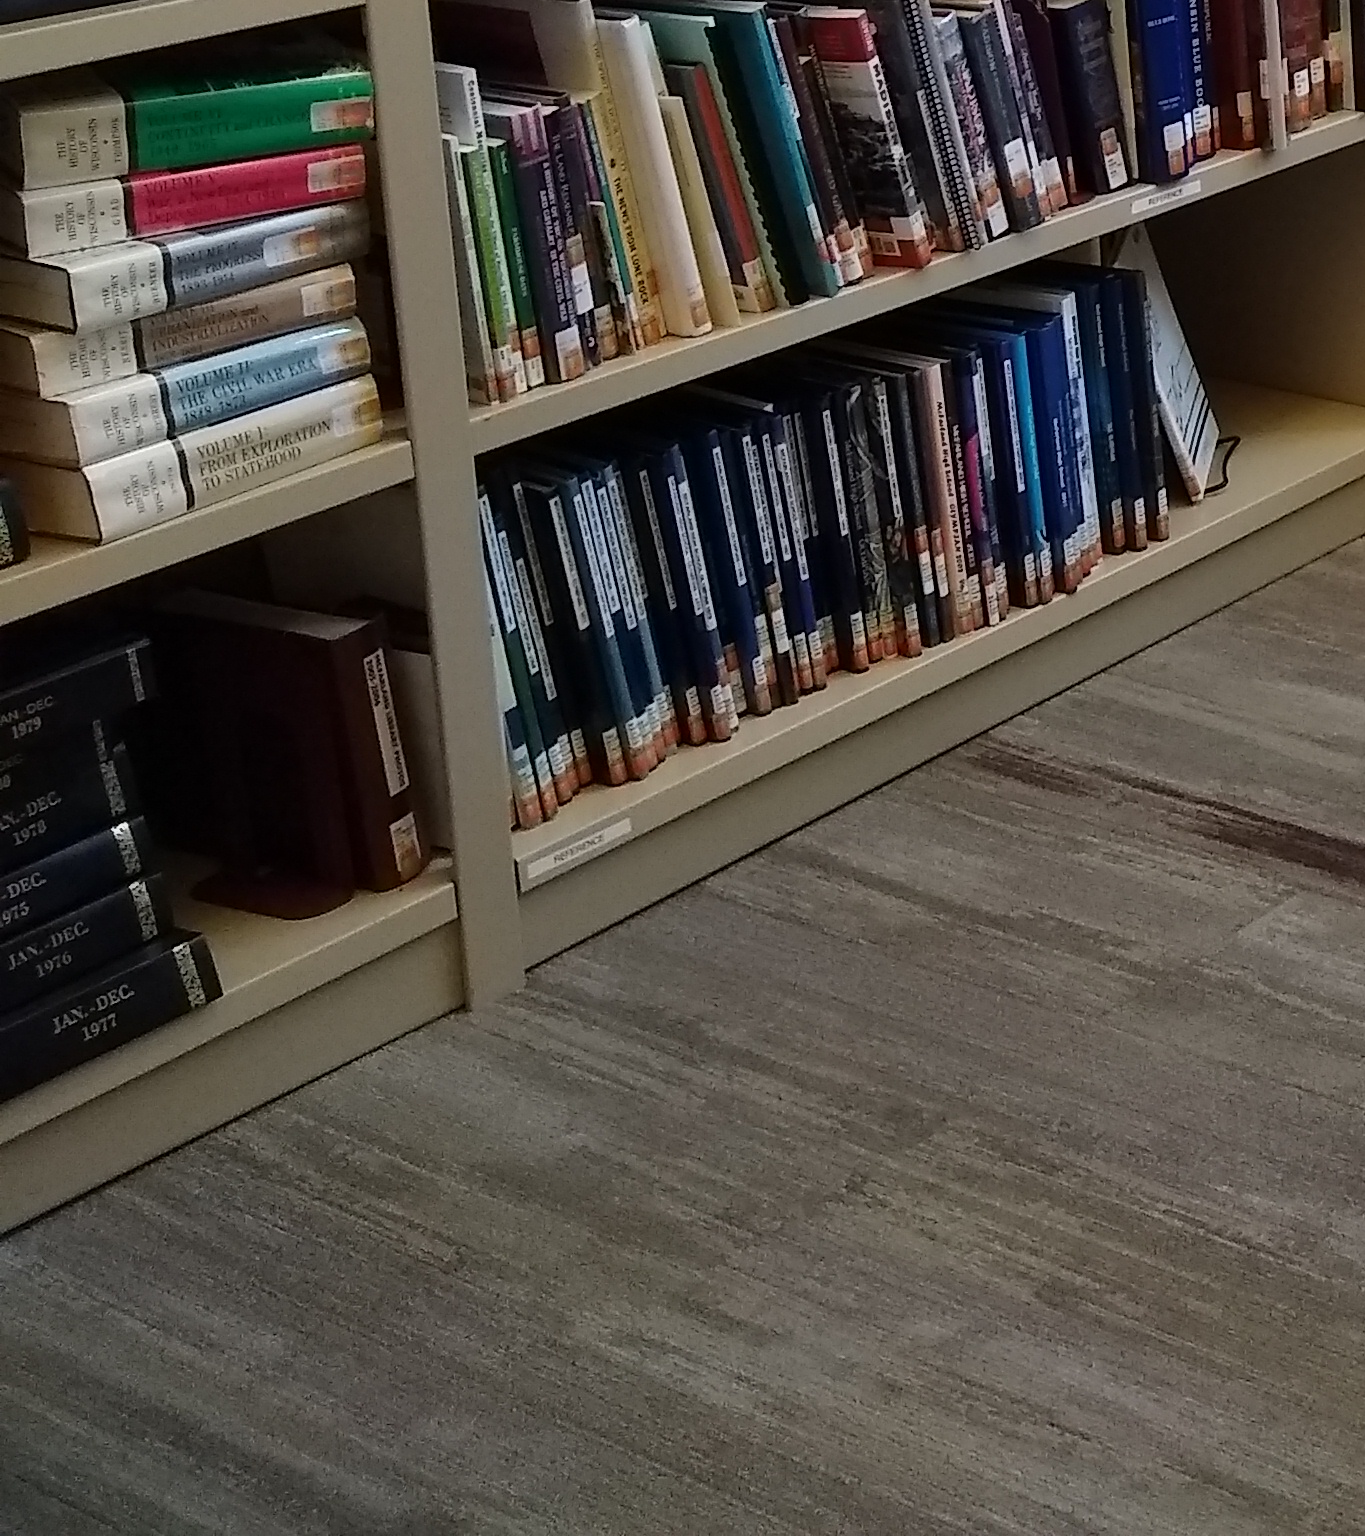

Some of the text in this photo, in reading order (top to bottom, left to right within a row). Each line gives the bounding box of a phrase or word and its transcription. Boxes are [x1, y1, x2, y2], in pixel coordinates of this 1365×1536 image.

[1191, 38, 1202, 74] BLUE
[873, 64, 899, 146] MADISON
[1195, 78, 1206, 109] BOO
[613, 177, 649, 305] THE NEWS FROM LONE ROCK
[176, 365, 234, 393] VOLUME
[178, 357, 319, 410] THE CIVIL WAR ERA
[196, 431, 252, 459] VOLUME
[199, 418, 332, 477] FROM EXPLORATION
[202, 446, 302, 492] TO STATEHOOD
[936, 401, 962, 553] McFarland High School OLYMPIAN
[11, 716, 42, 739] 1979
[13, 820, 48, 846] 1978
[8, 921, 90, 971] JAN.-DEC.
[35, 951, 73, 978] 1976
[52, 983, 135, 1034] JAN.-DEC.
[81, 1013, 118, 1042] 1977
